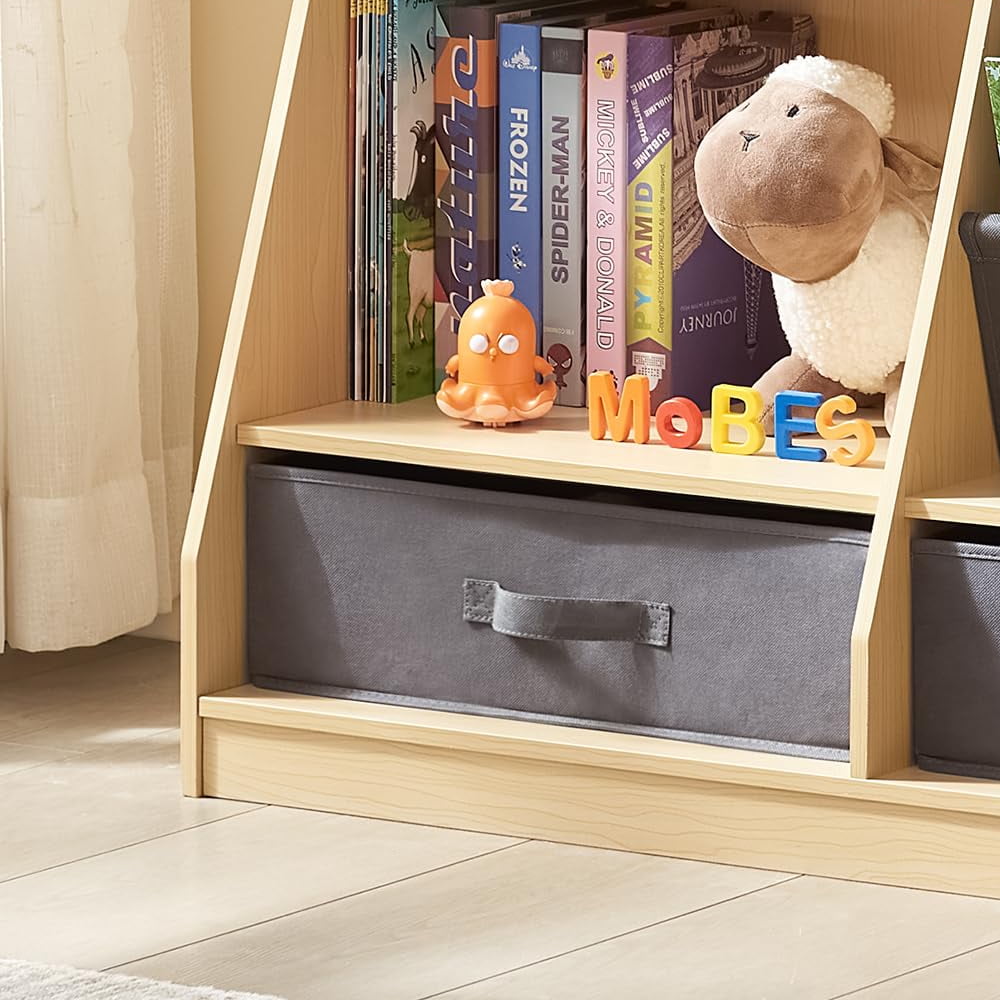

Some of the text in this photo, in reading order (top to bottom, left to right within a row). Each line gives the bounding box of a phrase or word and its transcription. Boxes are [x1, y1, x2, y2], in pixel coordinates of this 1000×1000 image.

[630, 64, 674, 95] SUBLIME
[509, 107, 528, 213] FROZEN
[551, 116, 570, 284] SPIDER-MAN
[632, 128, 670, 170] SUBLIME
[596, 100, 615, 351] MICKEY & DONALD
[634, 182, 653, 329] PYRAMID
[679, 307, 737, 333] JOURNEY
